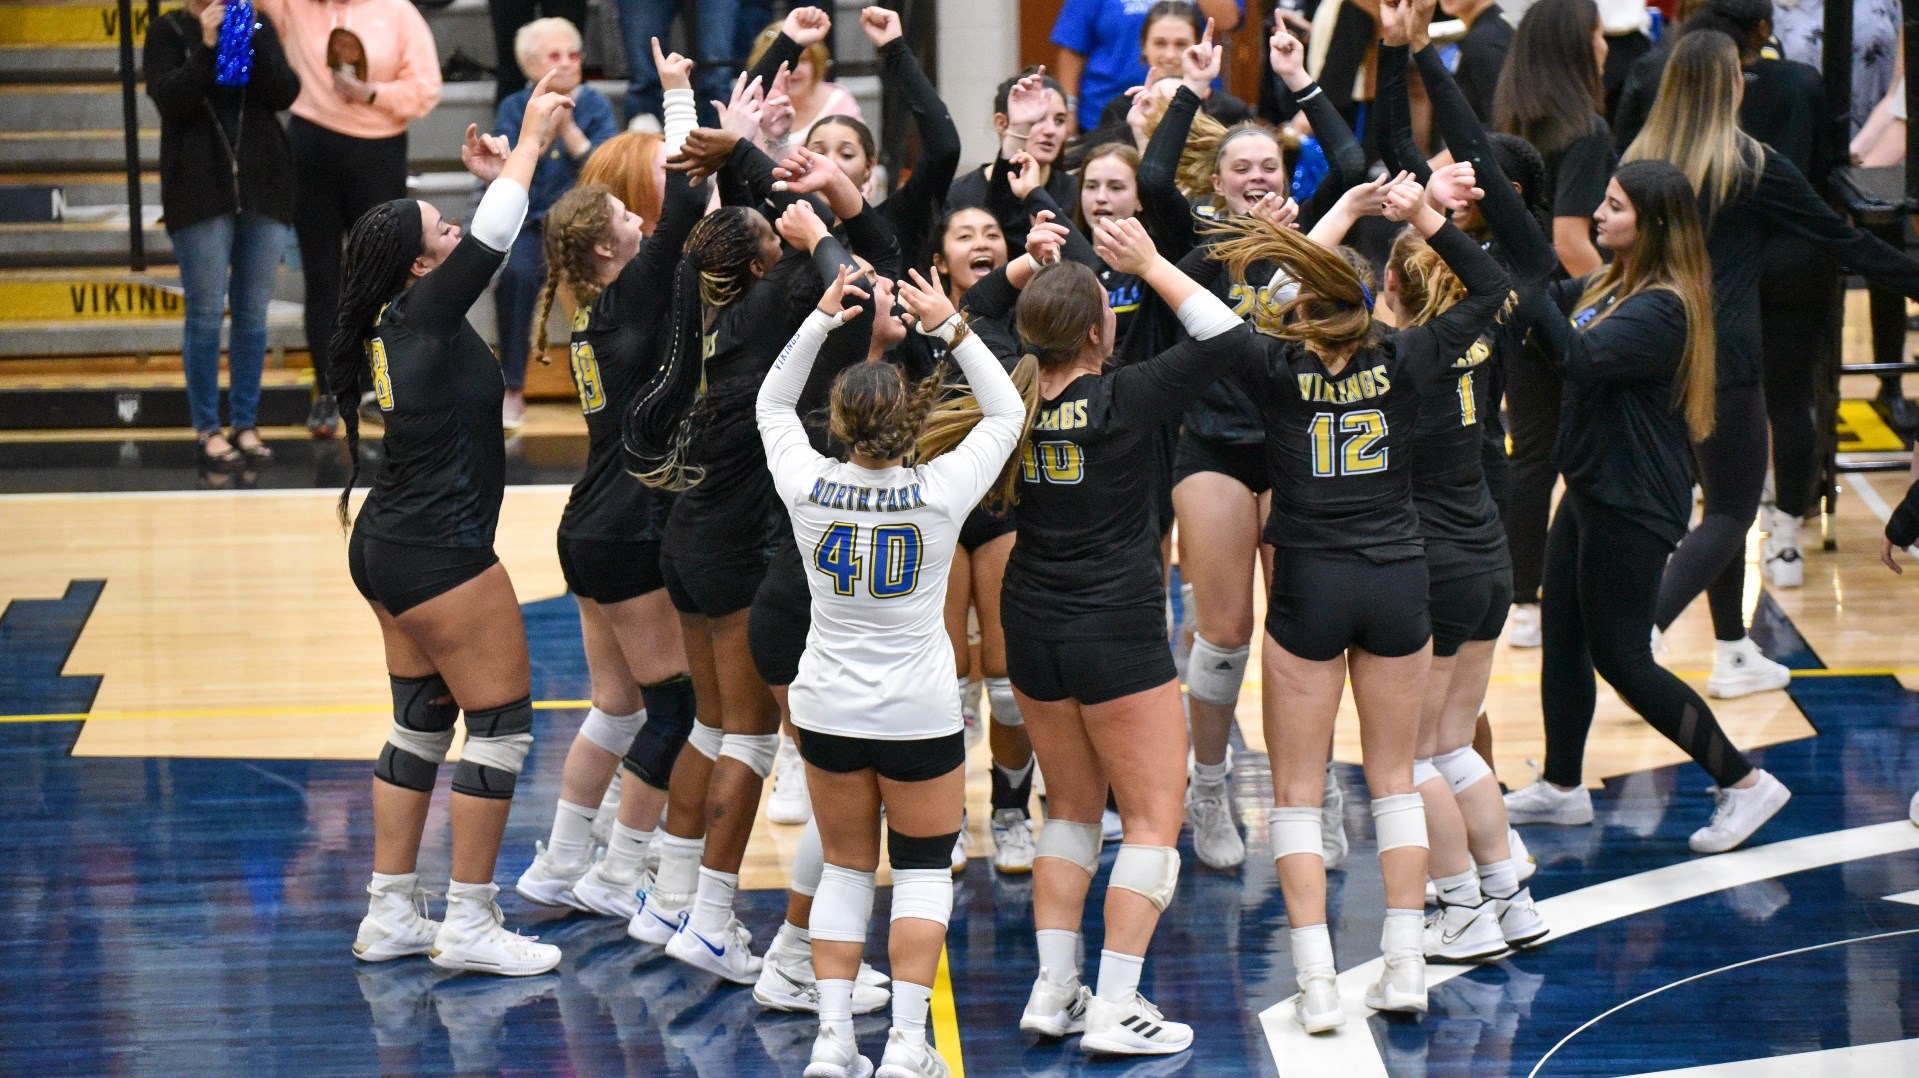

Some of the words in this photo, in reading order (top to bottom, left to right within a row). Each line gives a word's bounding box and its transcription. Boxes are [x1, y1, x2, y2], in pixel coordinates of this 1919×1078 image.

[774, 333, 801, 370] VIKINGS
[1297, 364, 1391, 404] VIKINGS
[1021, 440, 1085, 484] 10
[1307, 409, 1389, 478] 12
[808, 476, 872, 512] NORTH
[876, 483, 927, 513] PARK
[813, 521, 924, 599] 40
